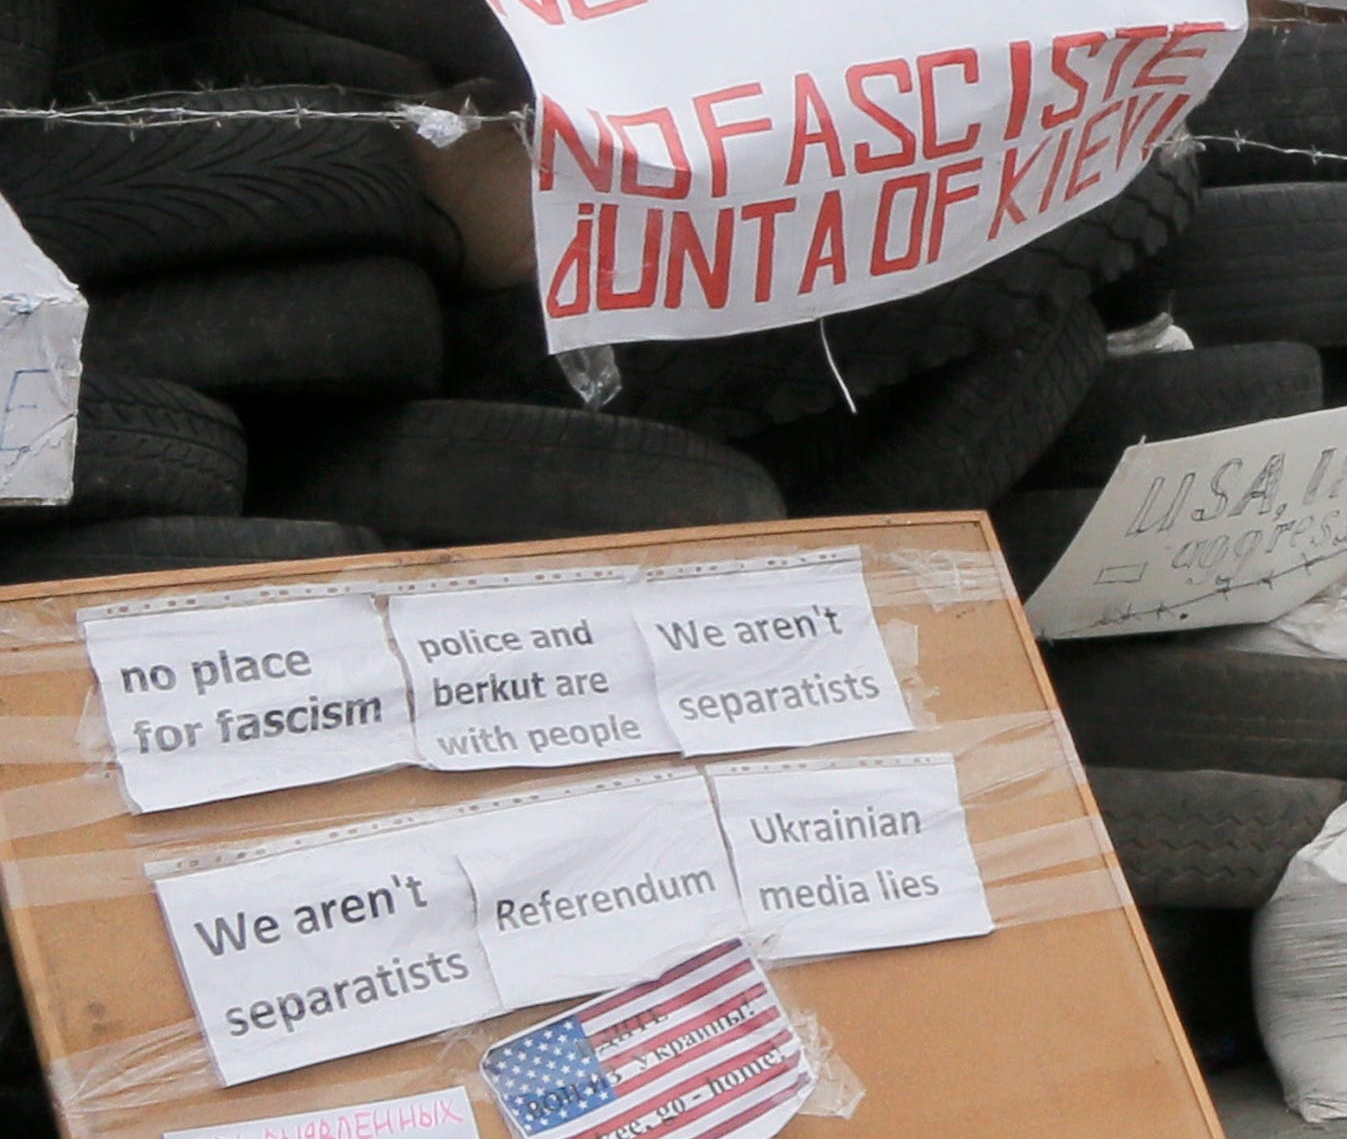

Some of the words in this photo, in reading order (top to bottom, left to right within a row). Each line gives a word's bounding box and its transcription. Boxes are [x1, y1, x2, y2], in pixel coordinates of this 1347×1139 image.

[537, 94, 692, 200] NO
[868, 156, 986, 276] OF
[1126, 453, 1287, 539] USA,
[418, 627, 523, 664] police
[532, 618, 594, 650] and
[656, 620, 728, 653] We
[735, 603, 844, 646] aren't
[121, 663, 177, 694] no
[192, 648, 312, 696] place
[432, 672, 546, 709] berkut
[555, 668, 610, 697] are
[677, 669, 881, 724] separatists
[132, 719, 203, 755] for
[215, 695, 383, 745] fascism
[437, 723, 519, 758] with
[526, 712, 643, 755] people
[750, 802, 923, 847] Ukrainian
[194, 910, 281, 958] We
[294, 872, 429, 938] aren't
[495, 863, 717, 934] Referendum
[759, 873, 872, 912] media
[878, 870, 940, 903] lies
[223, 950, 472, 1038] separatists
[706, 1048, 787, 1098] home!
